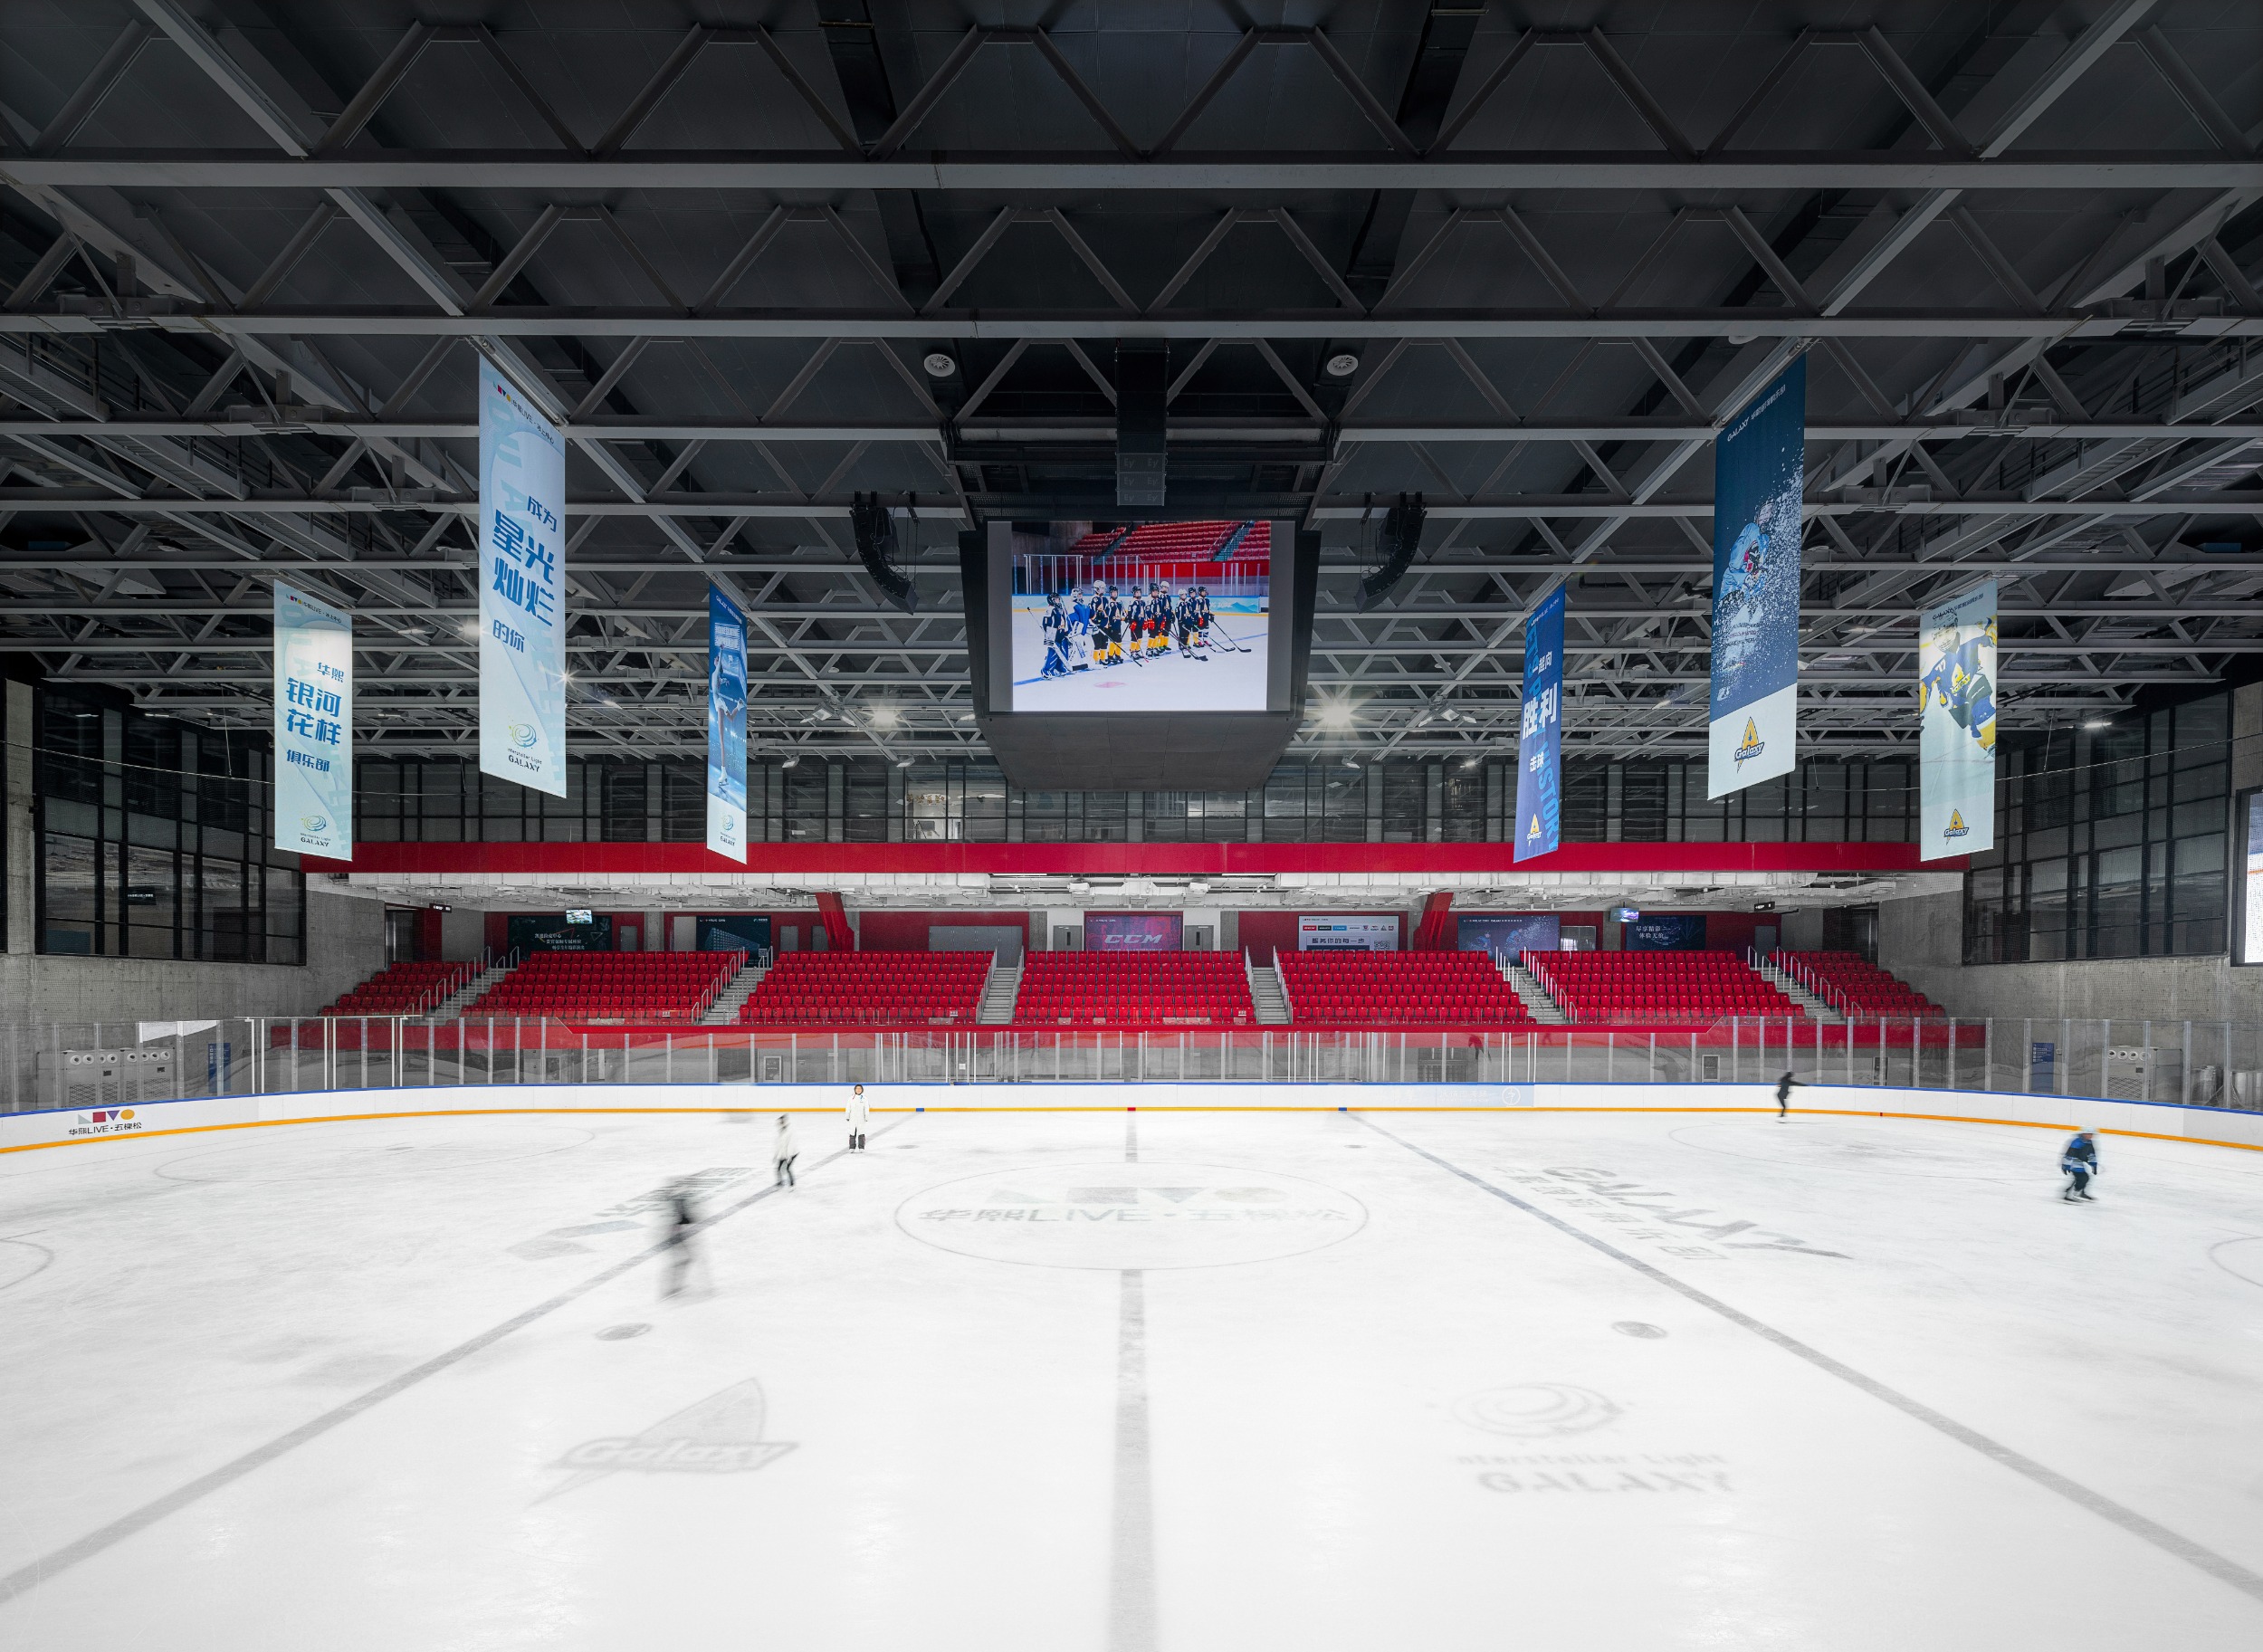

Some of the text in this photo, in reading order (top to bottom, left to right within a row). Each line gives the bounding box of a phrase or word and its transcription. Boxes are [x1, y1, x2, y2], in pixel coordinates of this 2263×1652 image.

[1727, 416, 1750, 442] GALAXY
[527, 495, 558, 533] 成为
[492, 509, 554, 586] 星光
[492, 557, 555, 627] 灿烂
[492, 619, 525, 654] 的你
[317, 662, 345, 683] 华熙
[286, 677, 342, 718] 银河
[1523, 682, 1558, 740] 胜利
[286, 709, 342, 746] 花样
[286, 749, 330, 772] 俱乐部
[508, 754, 540, 773] GALAXY
[1734, 741, 1765, 760] Galaxy
[301, 836, 329, 847] GALAXY
[1104, 934, 1163, 944] CCM
[1542, 1166, 1854, 1260] GALAXY
[1476, 1470, 1735, 1494] GALAXY
